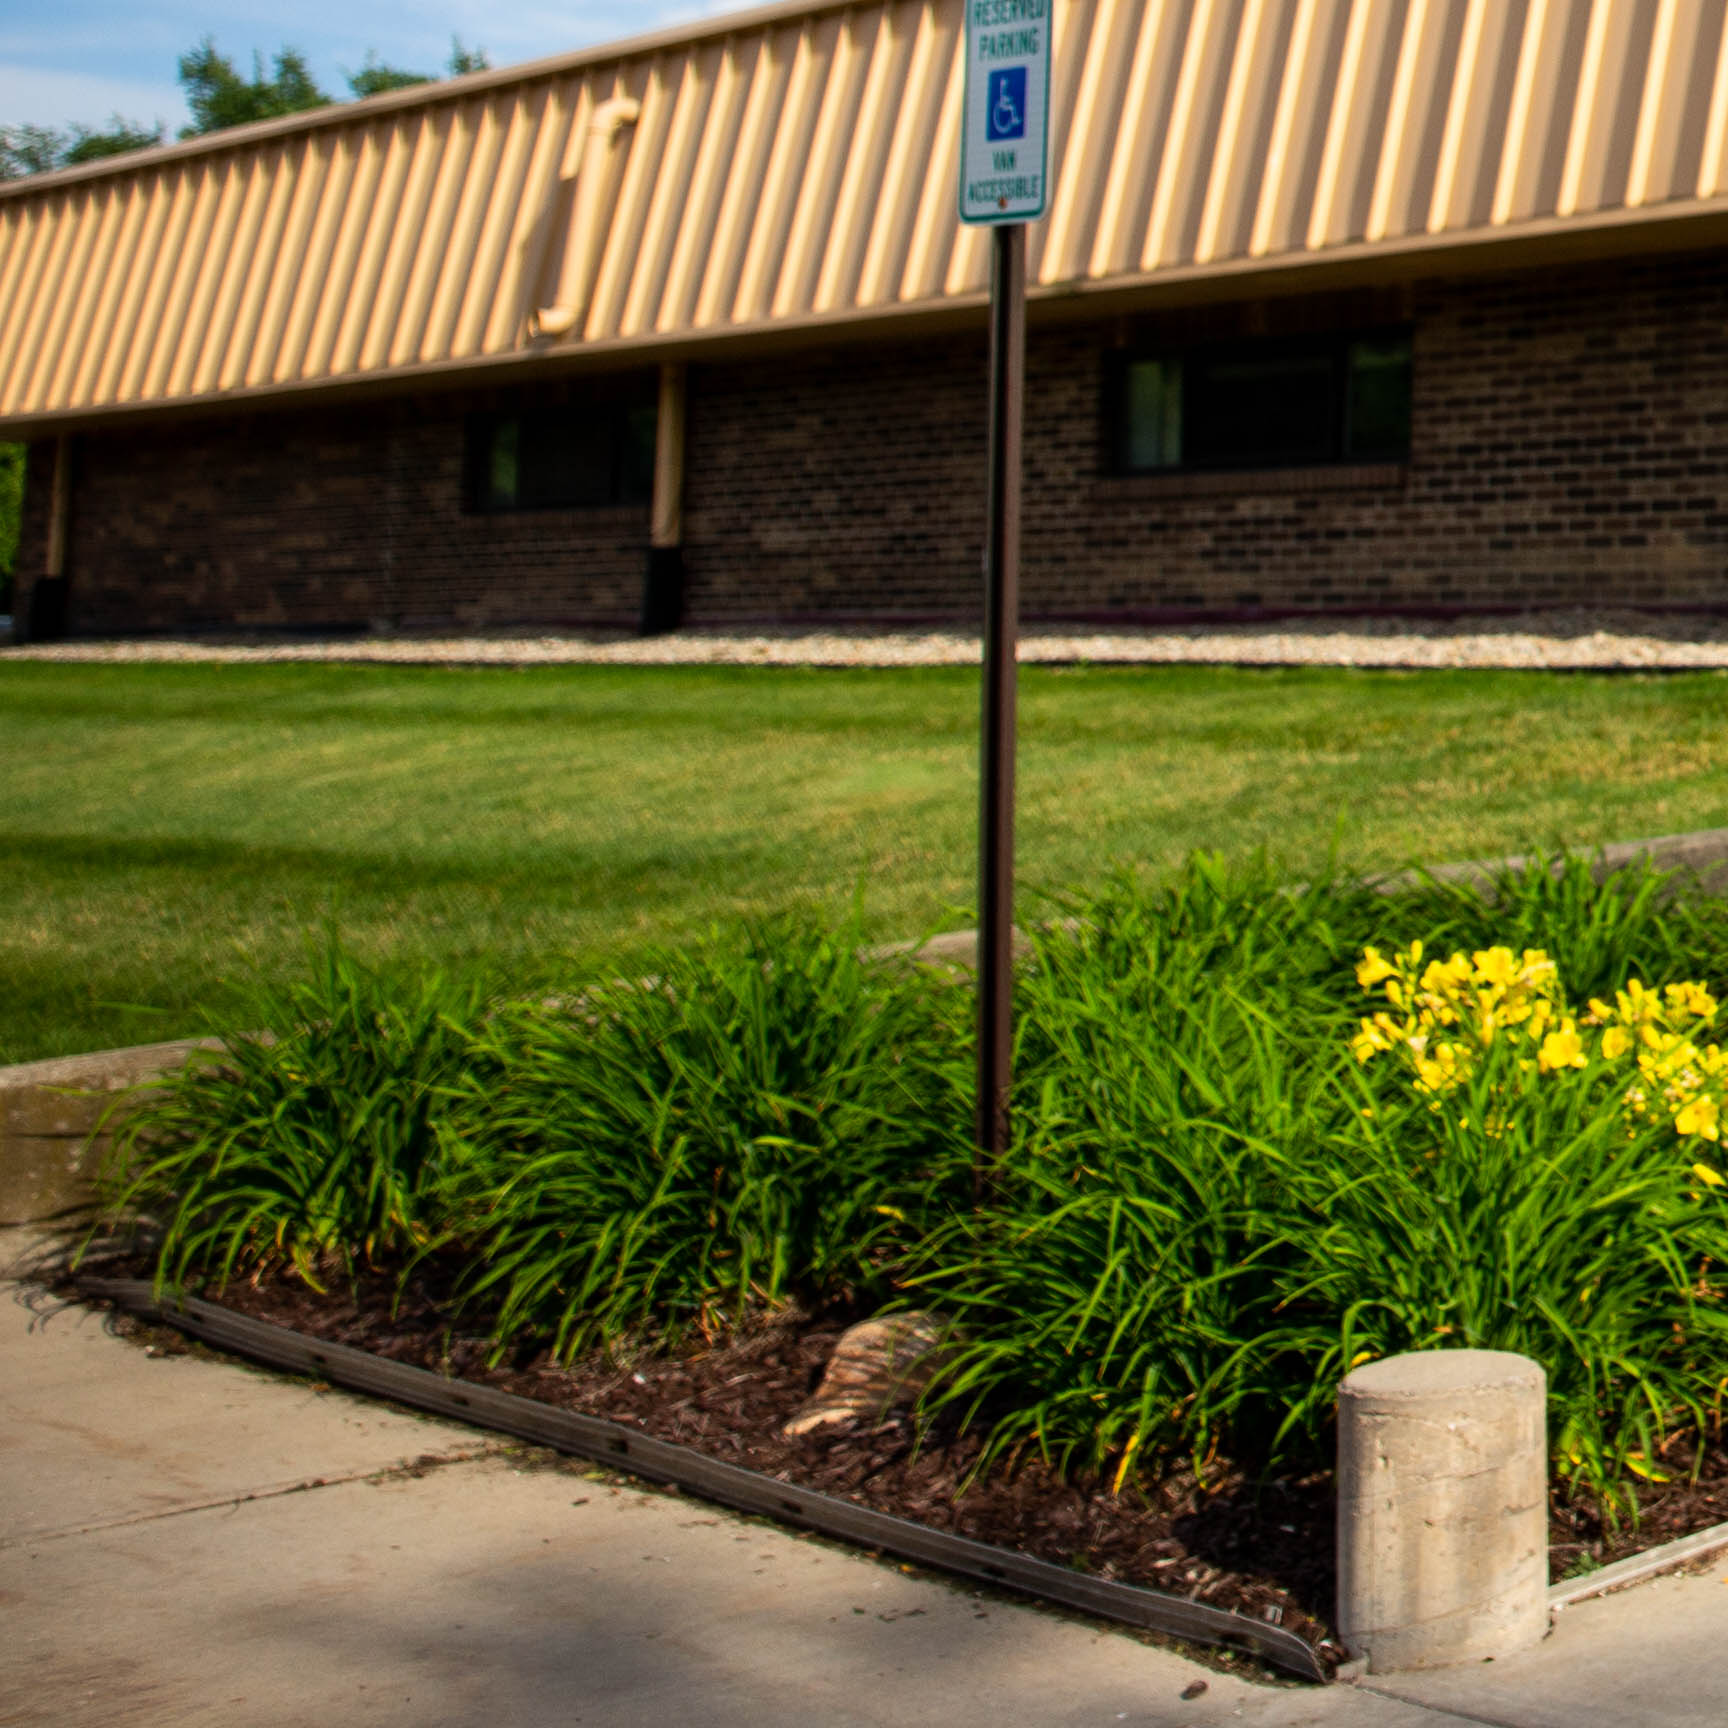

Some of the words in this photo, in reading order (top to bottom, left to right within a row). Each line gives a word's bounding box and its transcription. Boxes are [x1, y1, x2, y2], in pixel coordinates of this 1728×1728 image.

[979, 28, 1038, 60] PARKING
[993, 150, 1016, 171] VAN
[969, 175, 1039, 203] ACCESSIBLE
